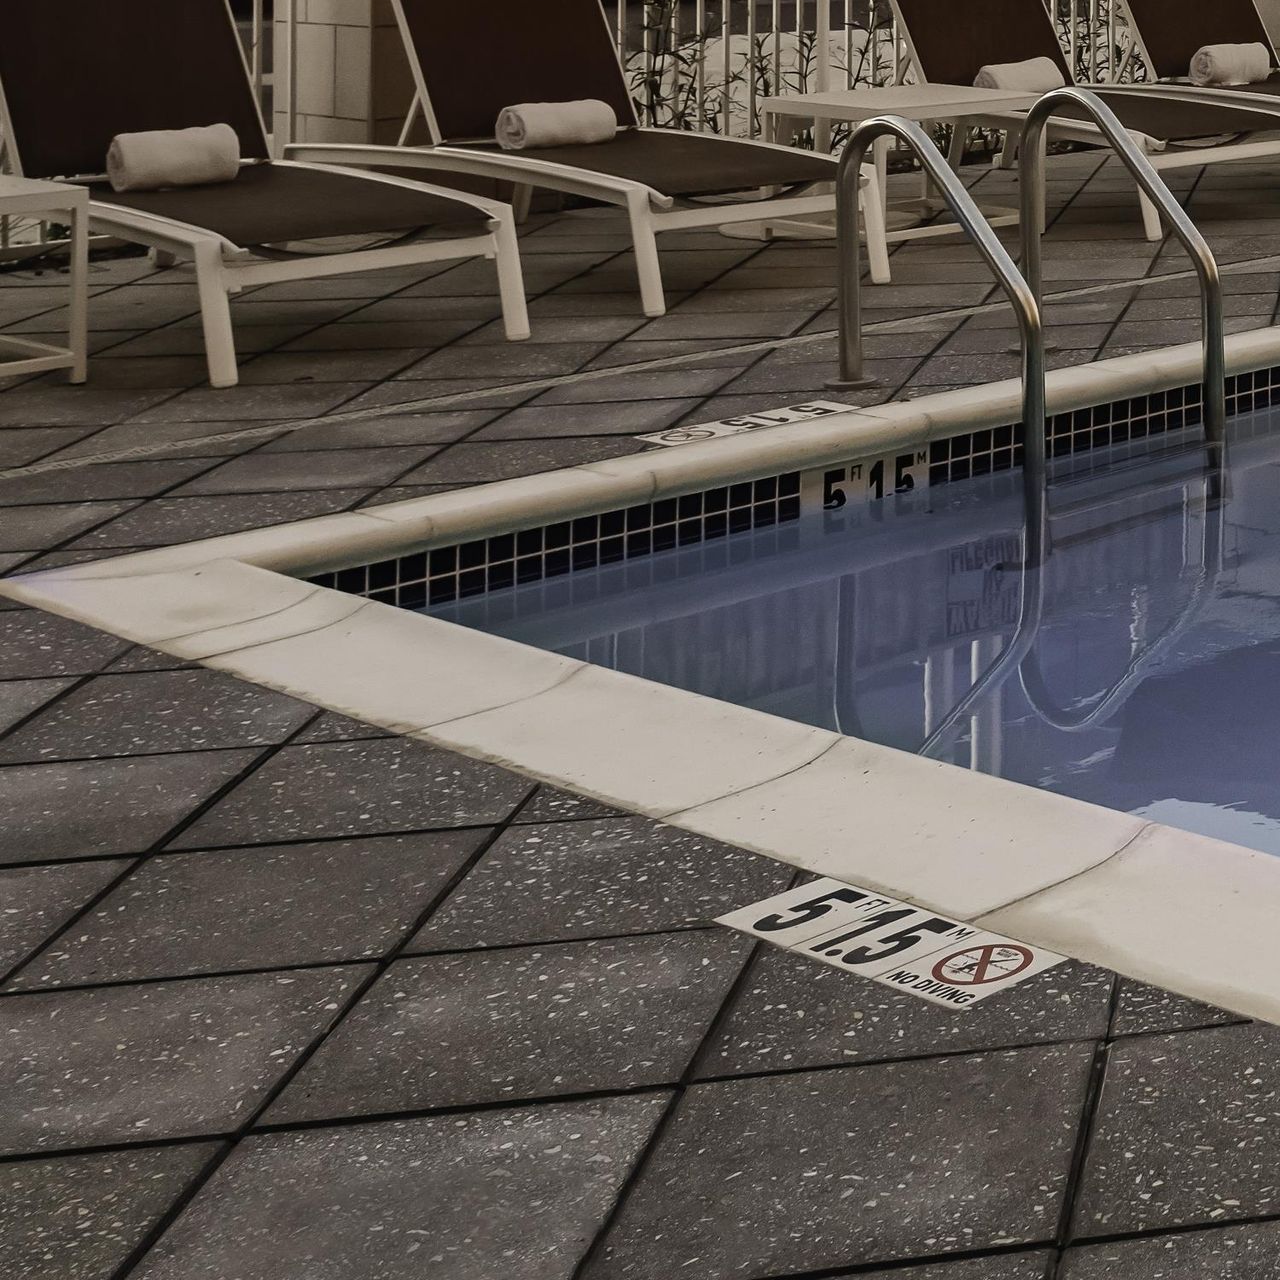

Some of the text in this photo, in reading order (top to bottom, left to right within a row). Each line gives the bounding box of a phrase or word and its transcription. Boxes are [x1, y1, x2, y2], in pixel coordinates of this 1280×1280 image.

[823, 468, 847, 510] 5
[850, 464, 863, 482] FT
[917, 449, 927, 464] M
[753, 888, 976, 965] 5 FT 1.5 M
[885, 970, 976, 1004] NO DIVING
